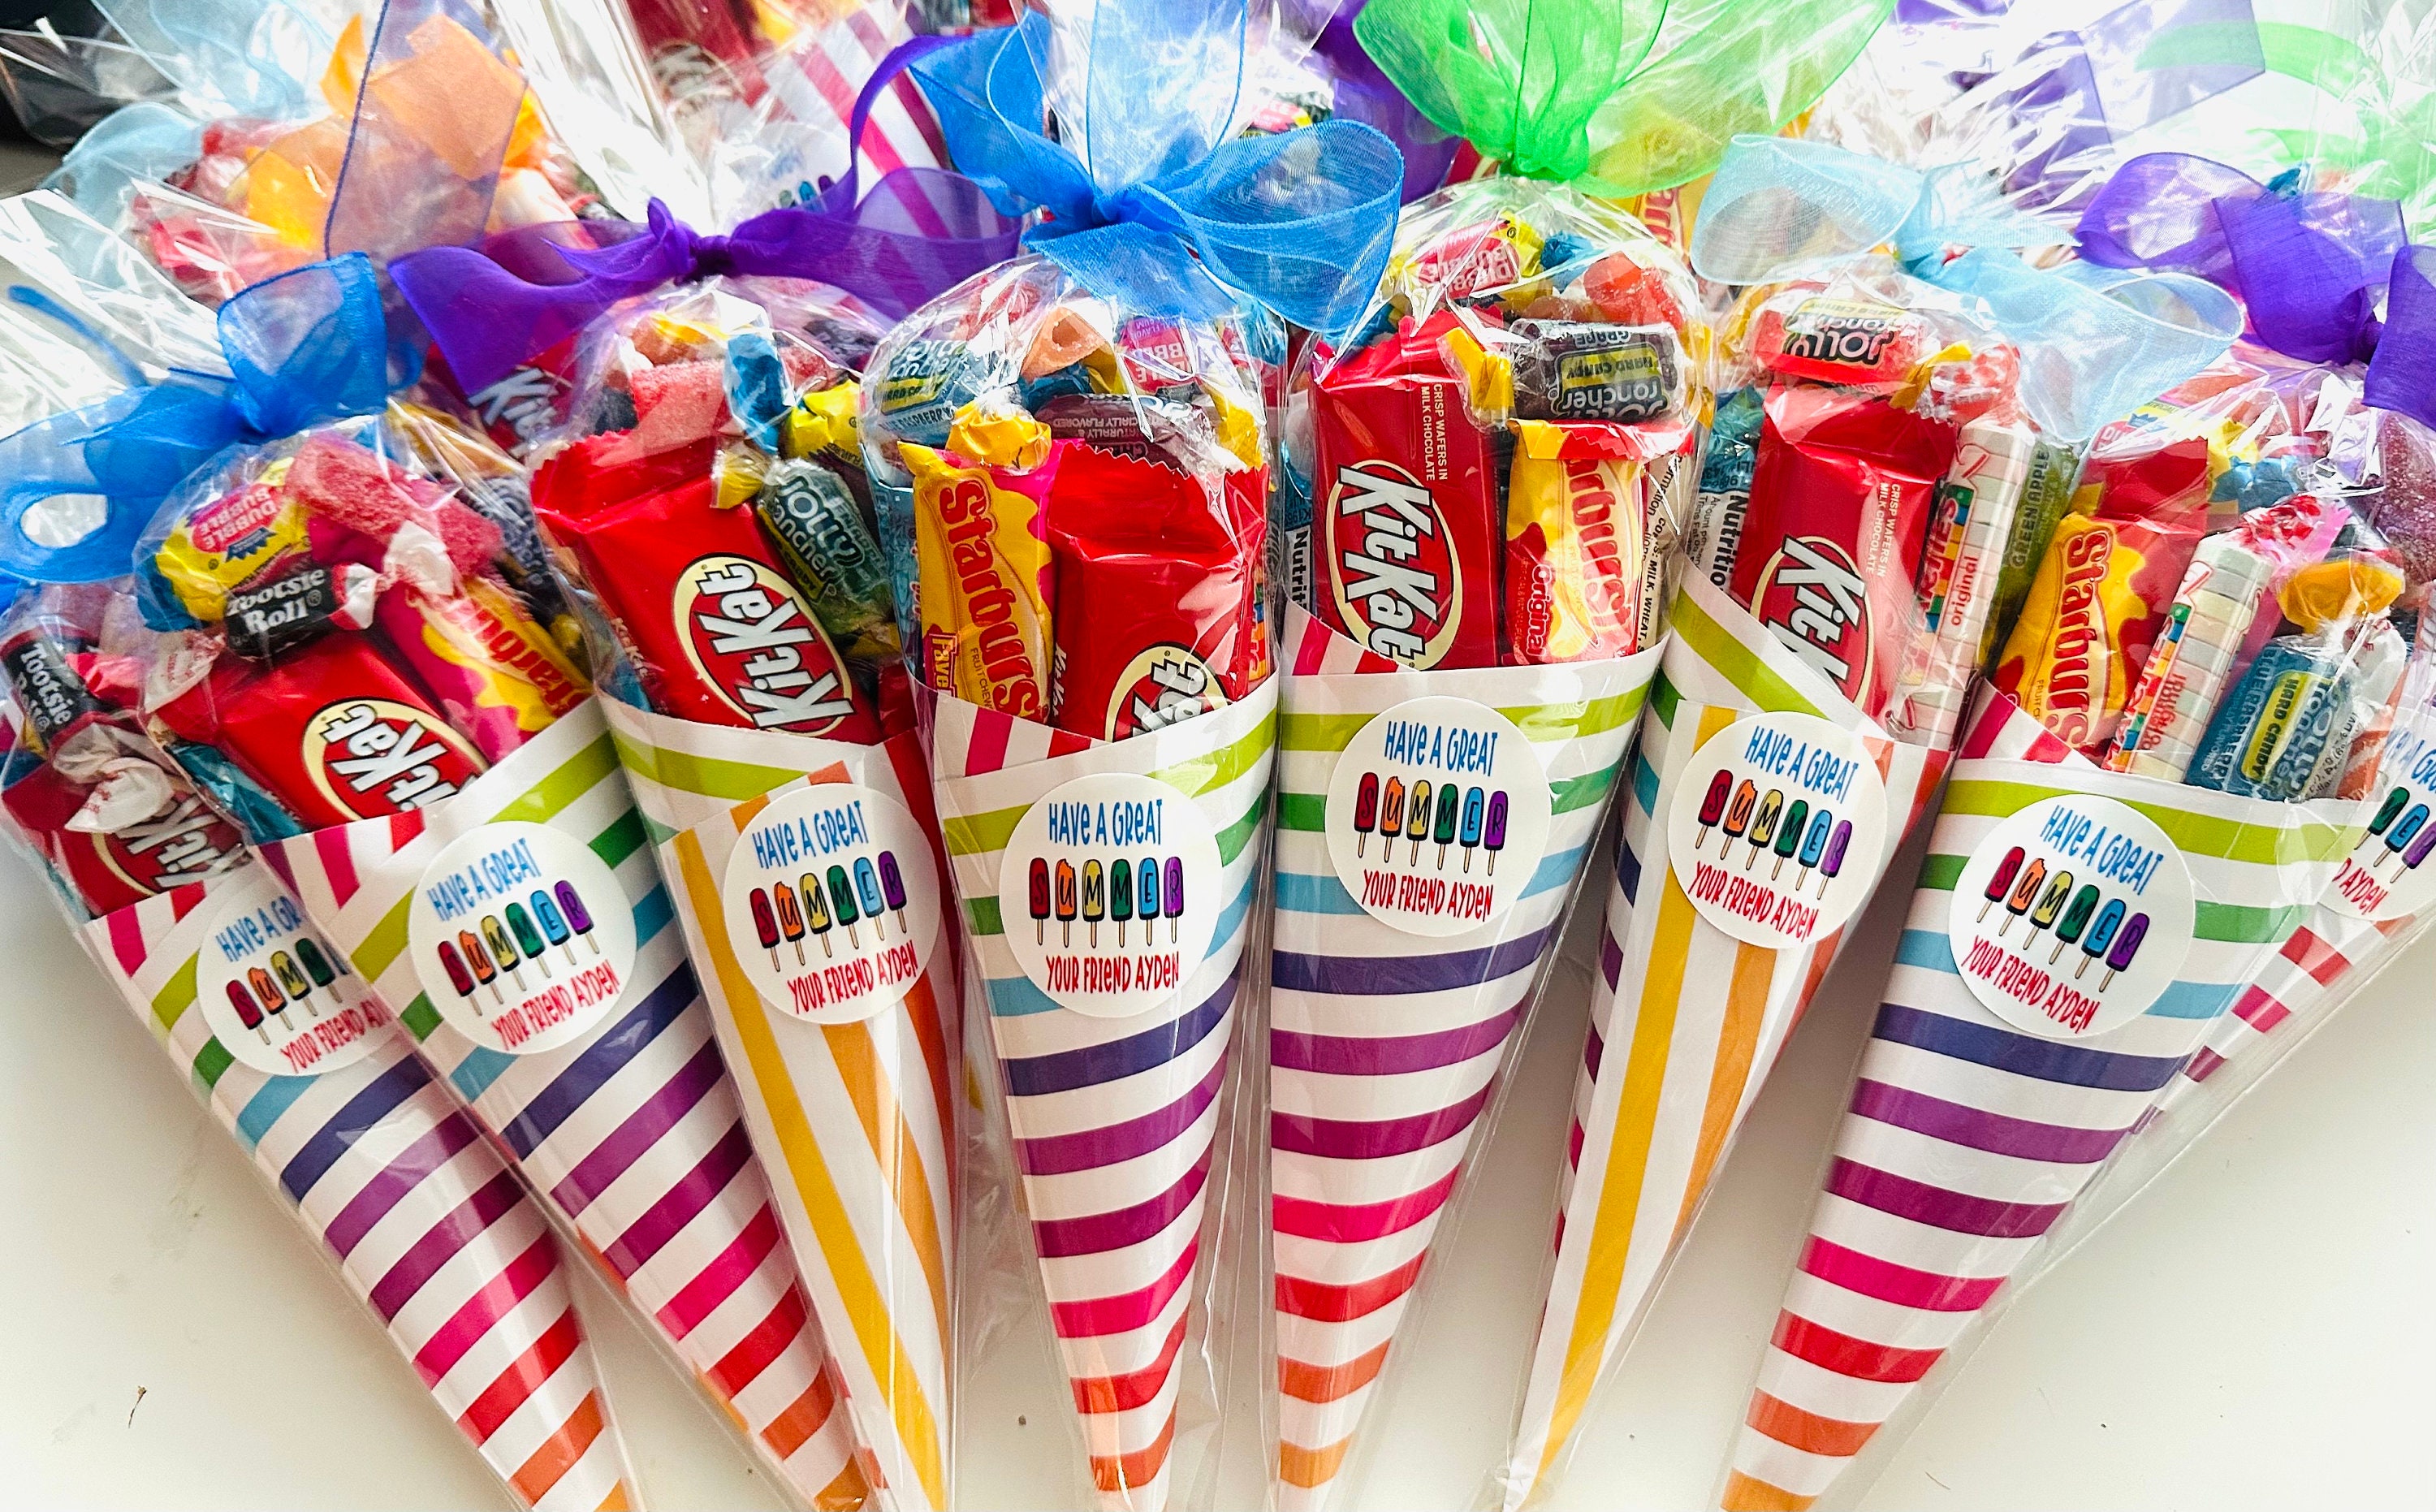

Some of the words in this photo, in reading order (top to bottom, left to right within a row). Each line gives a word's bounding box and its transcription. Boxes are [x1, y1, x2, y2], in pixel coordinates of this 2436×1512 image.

[1575, 330, 1630, 346] GRAPE
[1618, 356, 1654, 373] HARD
[1790, 329, 1890, 361] JOLLY
[1420, 385, 1432, 414] MILK
[1433, 383, 1445, 418] CRISP
[1561, 380, 1658, 410] rancher
[1422, 415, 1436, 482] CHOCOLATE
[1436, 419, 1448, 468] WAFERS
[1438, 468, 1449, 481] IN
[1877, 482, 1890, 508] MILK
[1889, 482, 1902, 517] CRISP
[203, 499, 279, 551] DUBBLE
[781, 480, 859, 559] JOLLY
[2010, 506, 2038, 568] GREEN
[2025, 449, 2052, 505] APPLE
[1338, 464, 1441, 660] KitKat
[1709, 495, 1749, 591] Nutritio
[1865, 510, 1886, 574] CHOCOLATE
[1881, 517, 1898, 564] WAFERS
[226, 568, 326, 617] Tootsie
[1291, 532, 1310, 611] Nutrit
[1877, 562, 1889, 578] IN
[1950, 555, 1980, 627] original
[244, 596, 309, 635] Roll
[1526, 563, 1553, 658] Original
[1765, 533, 1867, 697] KitK
[2044, 530, 2111, 746] Starburs
[693, 562, 855, 729] KitKat
[931, 636, 956, 689] Fave
[971, 646, 986, 676] FRUIT
[19, 642, 73, 727] Tootsie
[2274, 677, 2300, 721] HARD
[319, 703, 478, 813] itKat
[1384, 719, 1427, 767] HAVE
[1429, 724, 1442, 769] A
[1446, 728, 1499, 777] GREAT
[1744, 724, 1793, 775] HAVE
[1786, 742, 1808, 784] A
[1803, 747, 1859, 805] GREAT
[2249, 723, 2282, 779] CANDY
[116, 793, 254, 888] KitK
[751, 821, 799, 870] HAVE
[798, 816, 818, 858] A
[814, 799, 870, 854] GREAT
[1048, 801, 1091, 847] HAVE
[1095, 801, 1108, 846] A
[1112, 798, 1164, 847] GREAT
[2039, 804, 2093, 858] HAVE
[2080, 825, 2108, 867] A
[2097, 833, 2165, 896] GREAT
[467, 864, 493, 901] A
[1361, 868, 1397, 909] YOUR
[1397, 874, 1445, 916] FRIEND
[1446, 881, 1494, 922] AYDEN
[1687, 860, 1728, 905] YOUR
[1721, 875, 1775, 924] FRIEND
[1769, 896, 1820, 943] AYDEN
[787, 971, 827, 1015] YOUR
[823, 957, 875, 1004] FRIEND
[875, 939, 918, 986] AYDEN
[1045, 953, 1080, 993] YOUR
[1082, 957, 1133, 995] FRIEND
[1134, 950, 1180, 991] AYDEN
[1960, 934, 2005, 980] YOUR
[1993, 953, 2051, 1007] FRIEND
[2041, 981, 2101, 1035] AYDEN
